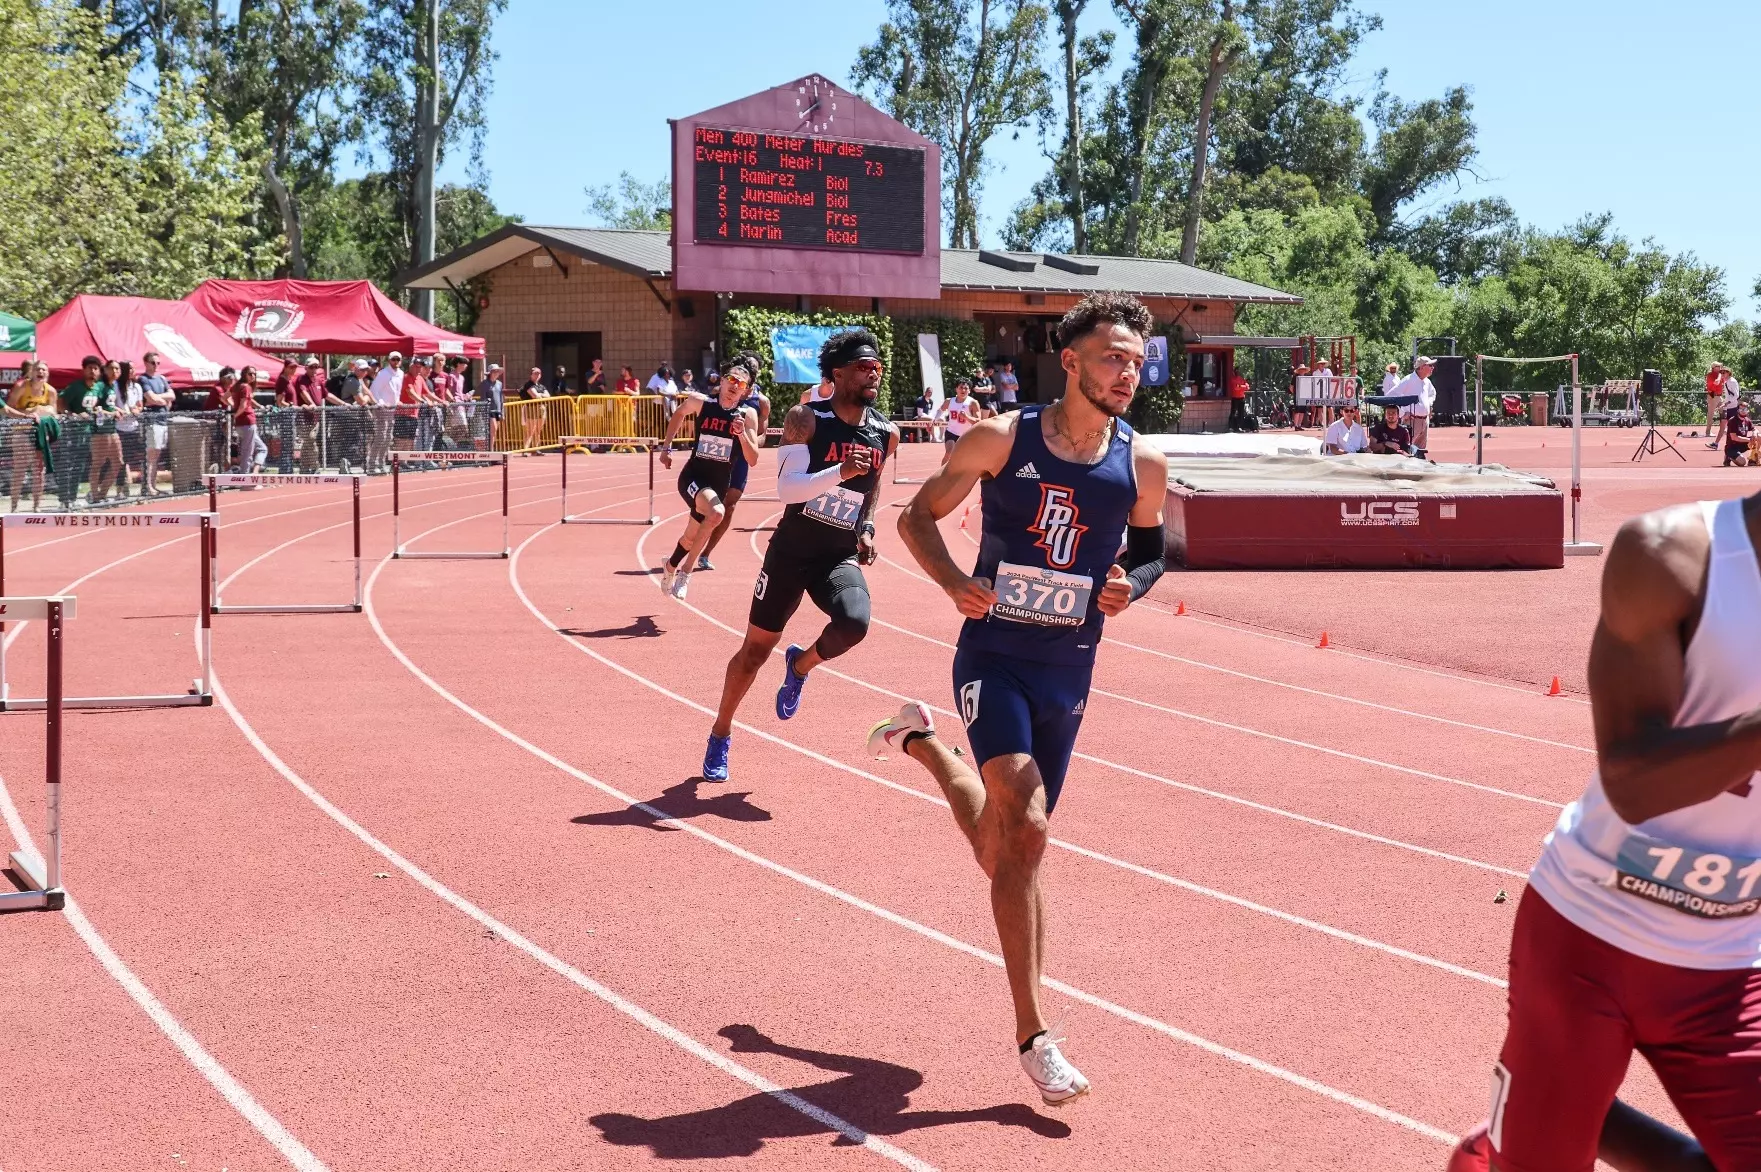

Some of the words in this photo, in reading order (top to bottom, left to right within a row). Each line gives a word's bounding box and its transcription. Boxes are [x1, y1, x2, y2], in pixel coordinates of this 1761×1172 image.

[831, 102, 837, 110] 3
[814, 124, 819, 132] 6
[695, 127, 724, 144] Men
[731, 131, 758, 147] 400
[765, 133, 806, 152] Meter
[813, 137, 864, 157] Hurdles
[719, 166, 725, 182] 1
[740, 167, 795, 187] Ramirez
[826, 175, 849, 191] Biol
[864, 160, 883, 177] 7.3
[718, 184, 727, 200] 2
[740, 186, 814, 206] Jungmichel
[826, 193, 849, 209] Biol
[718, 202, 727, 219] 3
[740, 204, 781, 222] Bates
[826, 210, 858, 227] Fres
[718, 221, 727, 237] 4
[740, 222, 782, 240] Marlin
[826, 229, 858, 244] Acad
[787, 347, 813, 359] MAKE
[701, 417, 727, 432] ART
[424, 452, 477, 460] WESTMONT
[702, 443, 726, 456] 121
[250, 475, 321, 484] WESTMONT
[1015, 470, 1041, 479] adidas
[806, 508, 853, 528] CHAMPIONSHIPS
[816, 496, 857, 520] 117
[1340, 501, 1420, 519] UCS
[24, 517, 47, 525] GILL
[54, 515, 153, 526] WESTMONT
[1005, 578, 1076, 614] 370
[995, 604, 1078, 626] CHAMPIONSHIPS
[963, 683, 975, 724] 6
[1648, 846, 1761, 899] 181
[1621, 875, 1758, 916] CHAMPIONSPS
